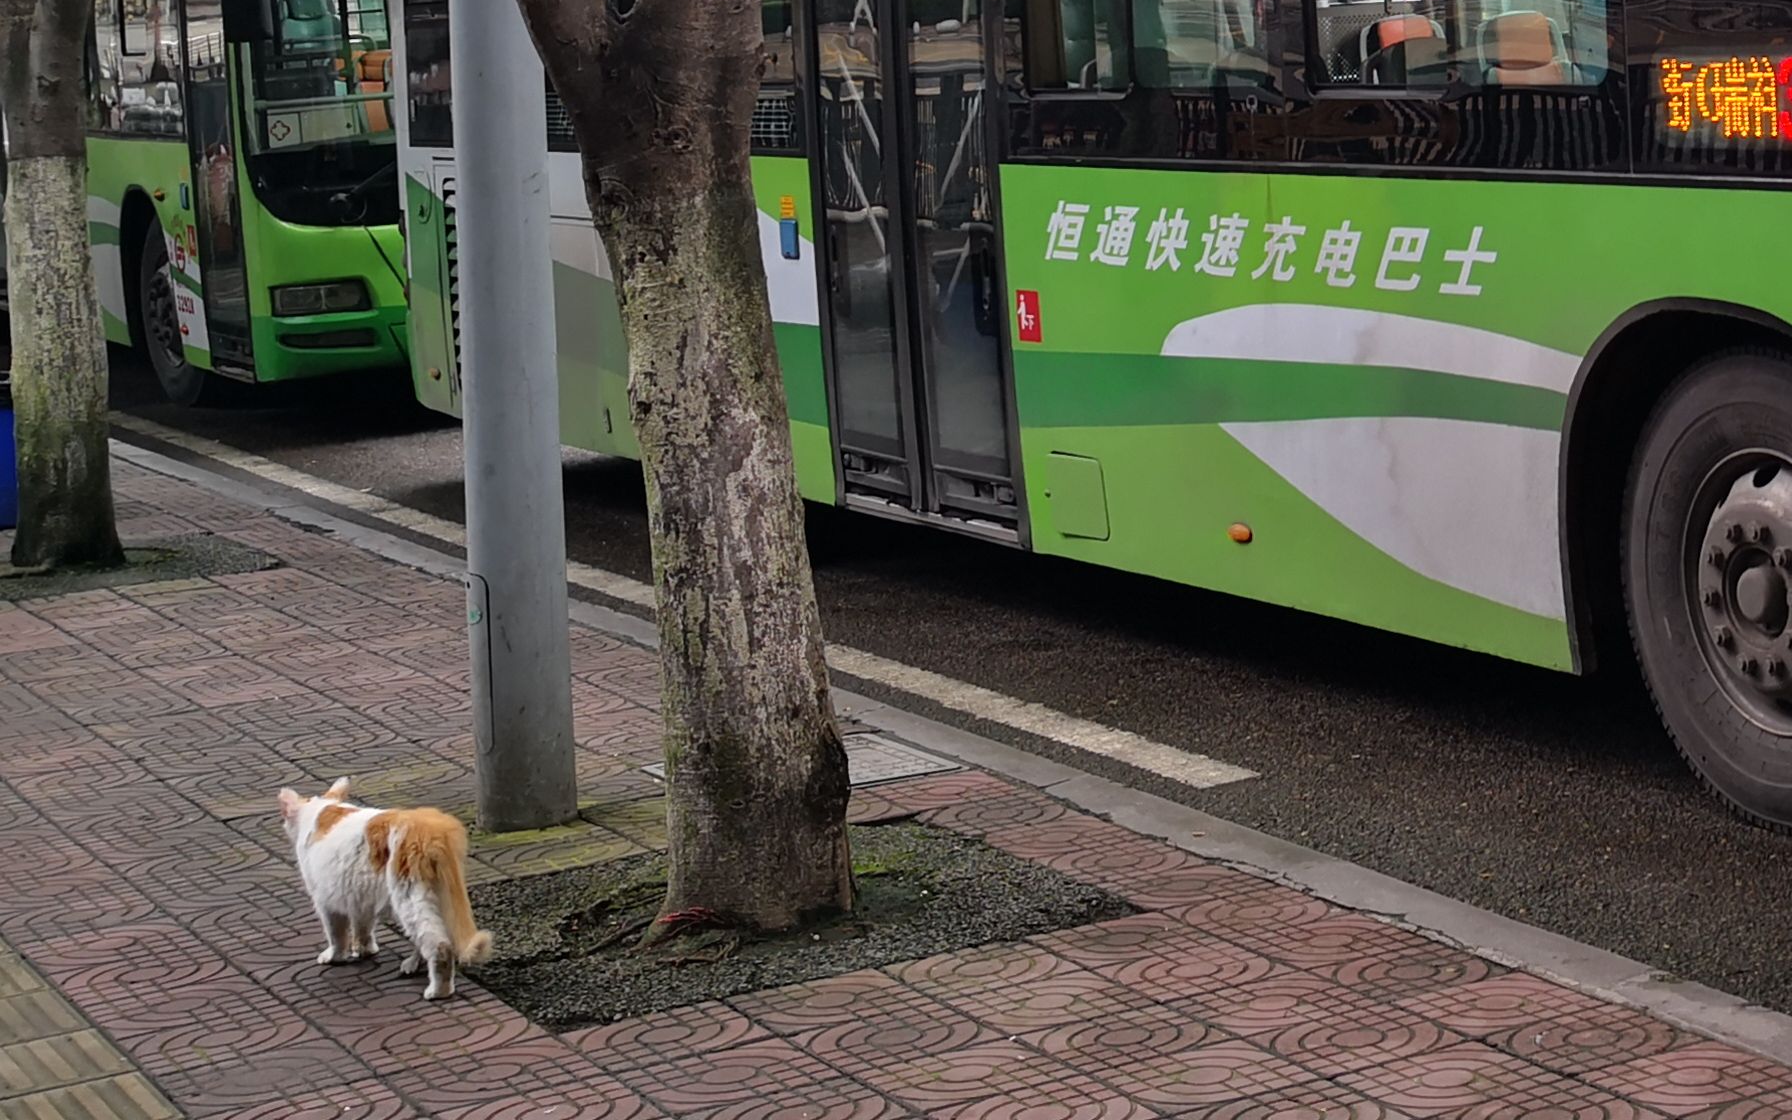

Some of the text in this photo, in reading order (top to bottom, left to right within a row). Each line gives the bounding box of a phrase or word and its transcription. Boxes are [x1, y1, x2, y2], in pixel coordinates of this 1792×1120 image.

[1045, 200, 1497, 296] 恒通快速充电巴士
